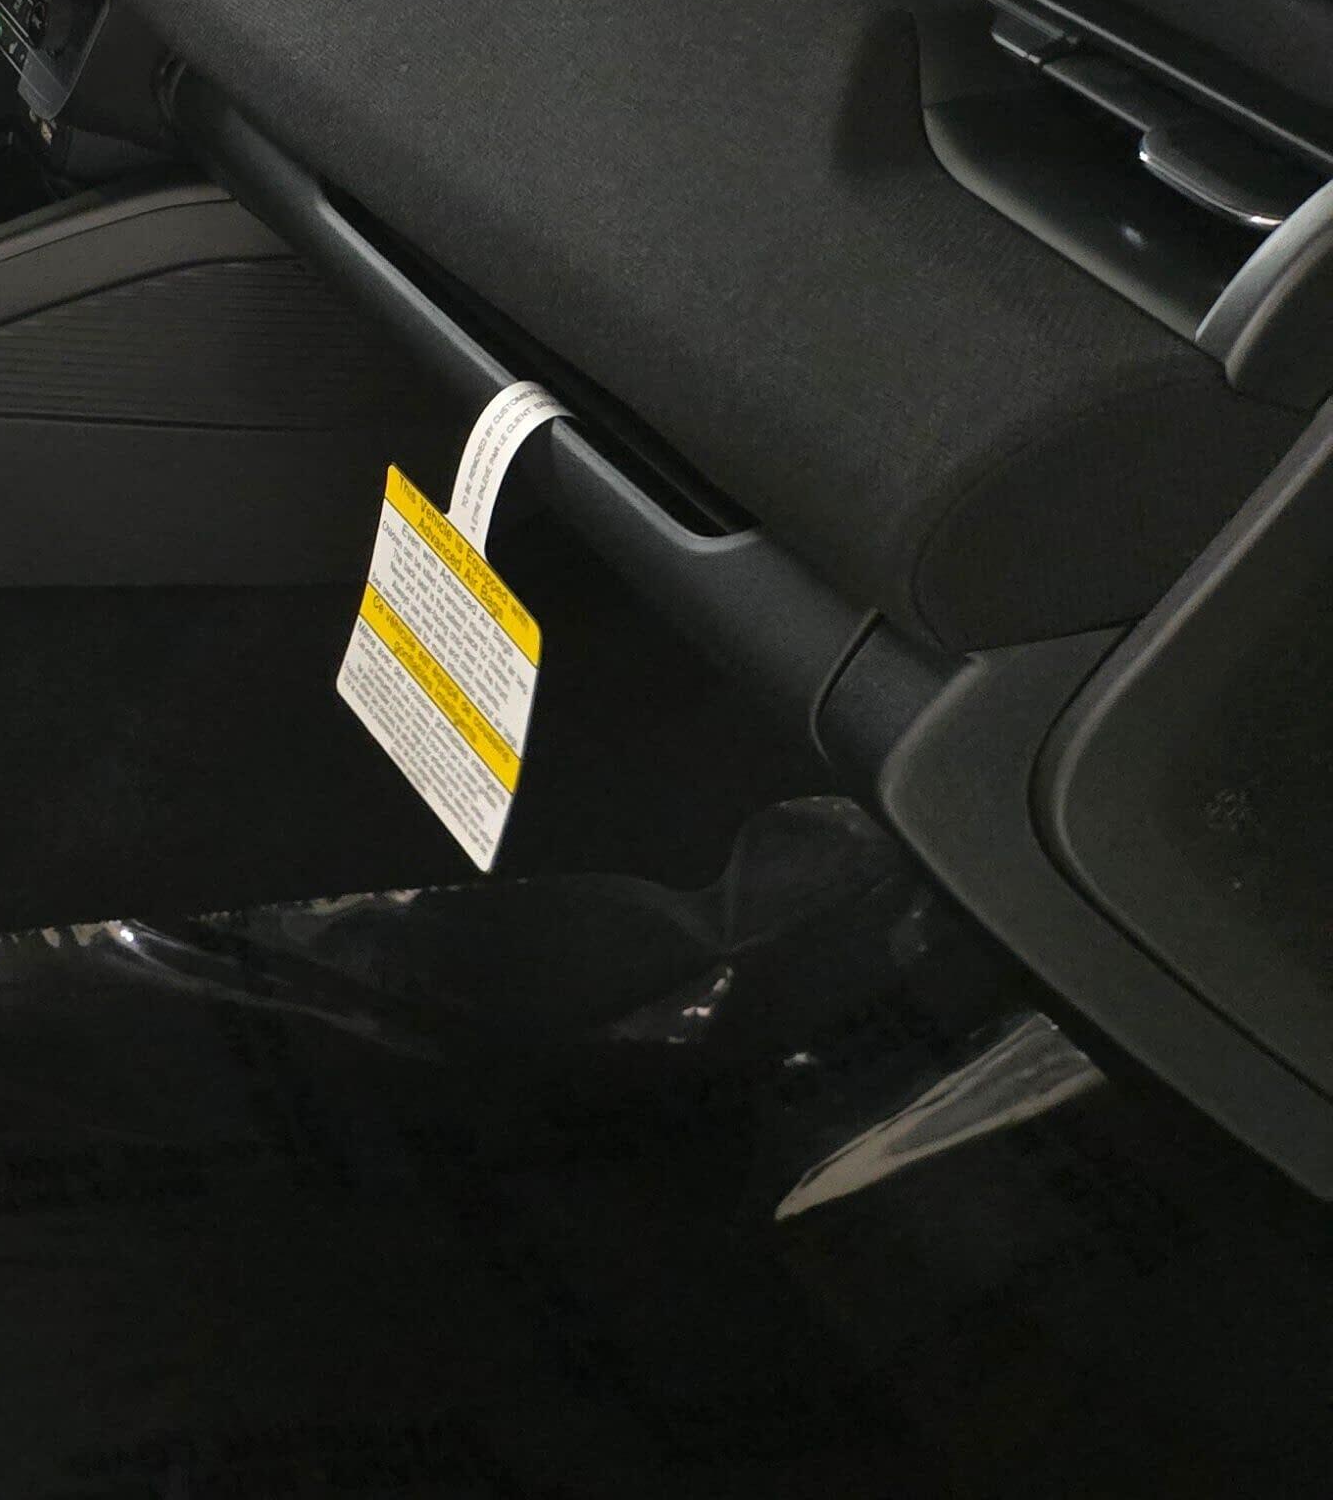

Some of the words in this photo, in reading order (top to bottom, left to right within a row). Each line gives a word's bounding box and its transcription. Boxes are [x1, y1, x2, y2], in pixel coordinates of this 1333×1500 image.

[417, 514, 462, 573] Advanced
[464, 566, 478, 589] Air
[418, 496, 453, 543] Vehicle
[464, 546, 509, 608] Equipped
